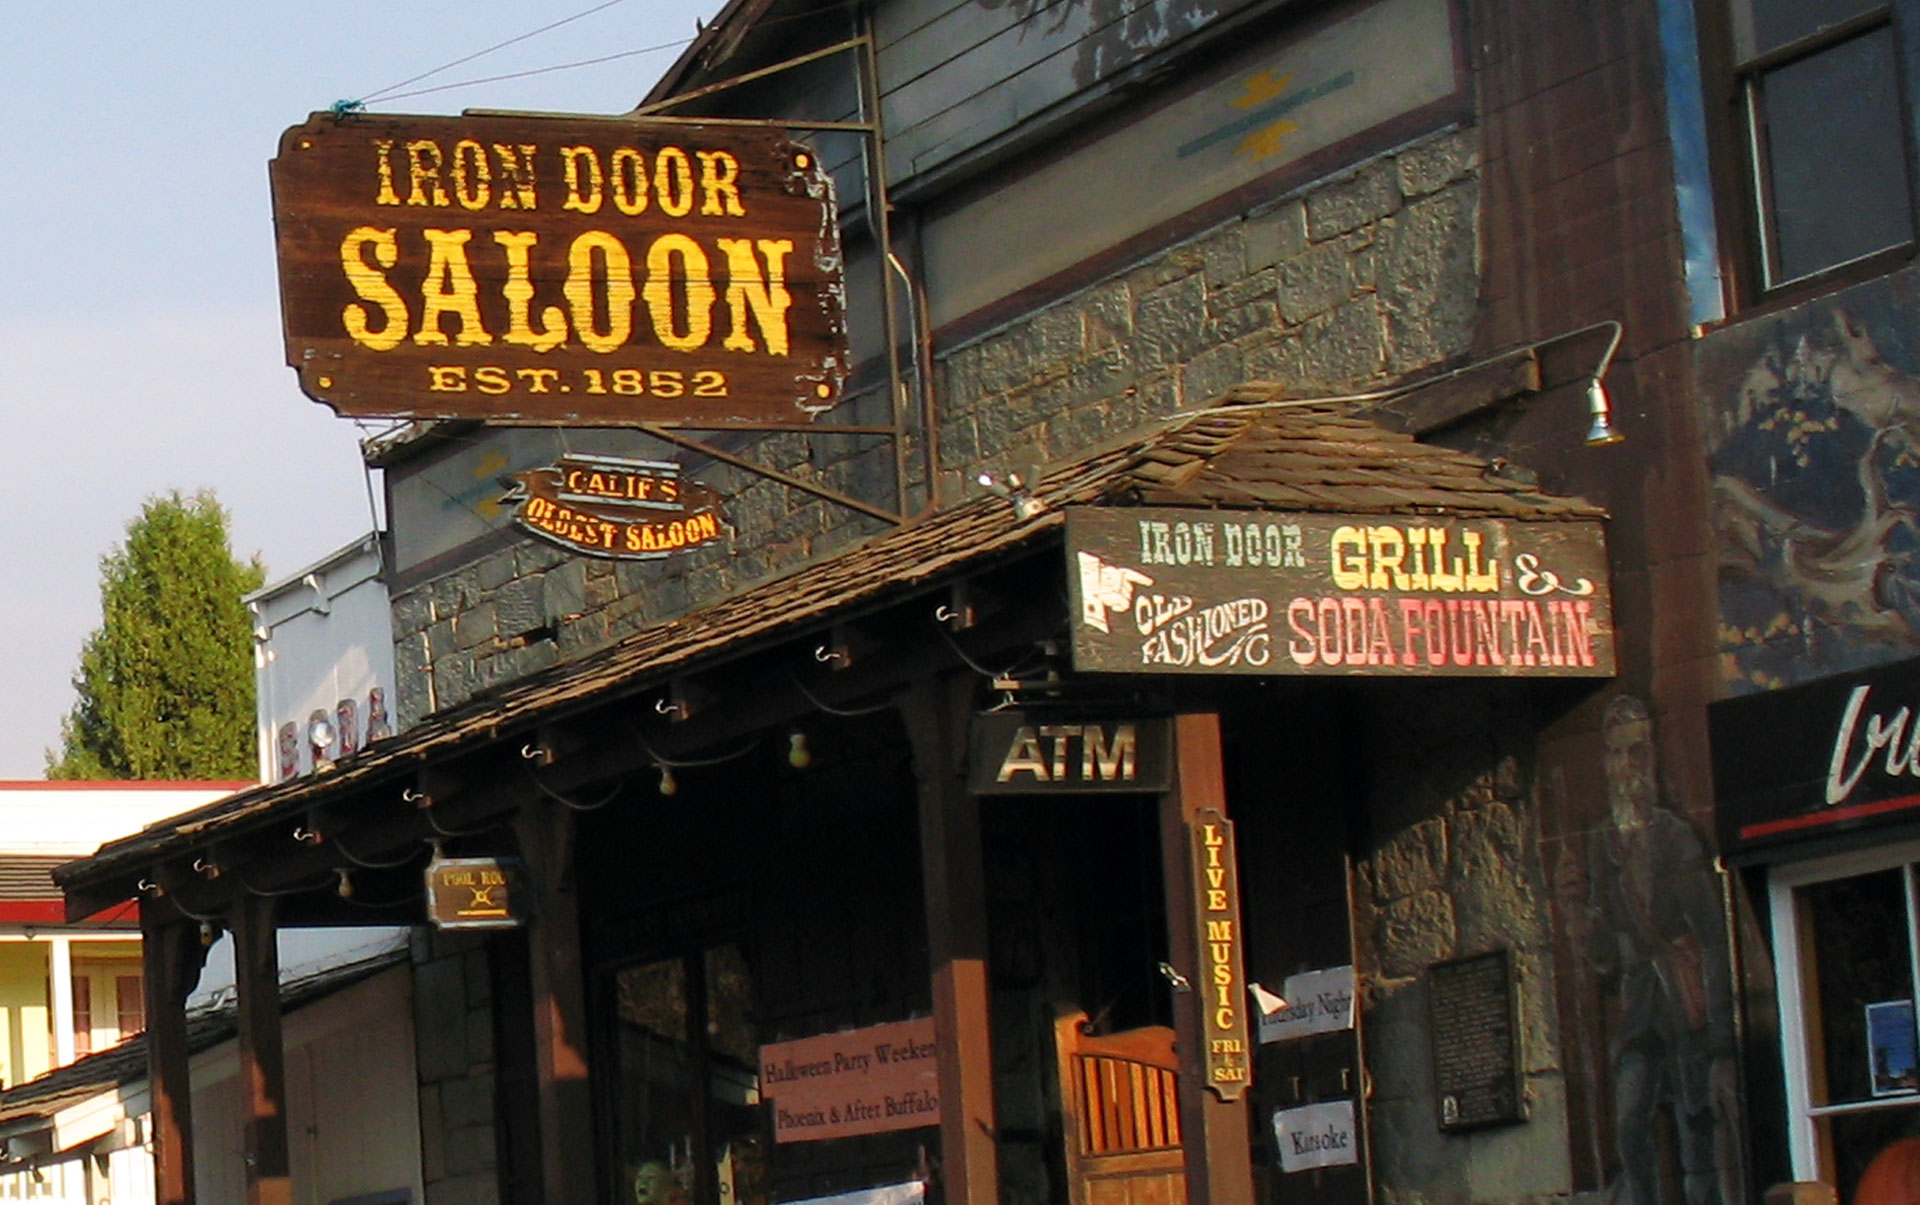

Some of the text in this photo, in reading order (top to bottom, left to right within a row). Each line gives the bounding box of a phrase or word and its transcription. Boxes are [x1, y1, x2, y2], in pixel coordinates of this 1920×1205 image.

[371, 138, 745, 217] IRON DOOR
[340, 225, 794, 357] SALOON
[428, 365, 728, 397] EST. 1852
[526, 496, 717, 552] OLDEST SALOON
[1139, 519, 1595, 596] IRON DOOR GRILL &
[1135, 594, 1193, 636] OLD
[1141, 597, 1269, 667] FASHIONED
[1287, 597, 1597, 668] SODA FOUNTAIN
[996, 725, 1136, 783] ATM
[1203, 824, 1234, 1030] LIVE MUSIC
[765, 1058, 832, 1084] Halloween
[834, 1052, 871, 1074] Party
[1213, 1067, 1244, 1081] SAT
[778, 1088, 938, 1130] Phoenix & After Buffalo
